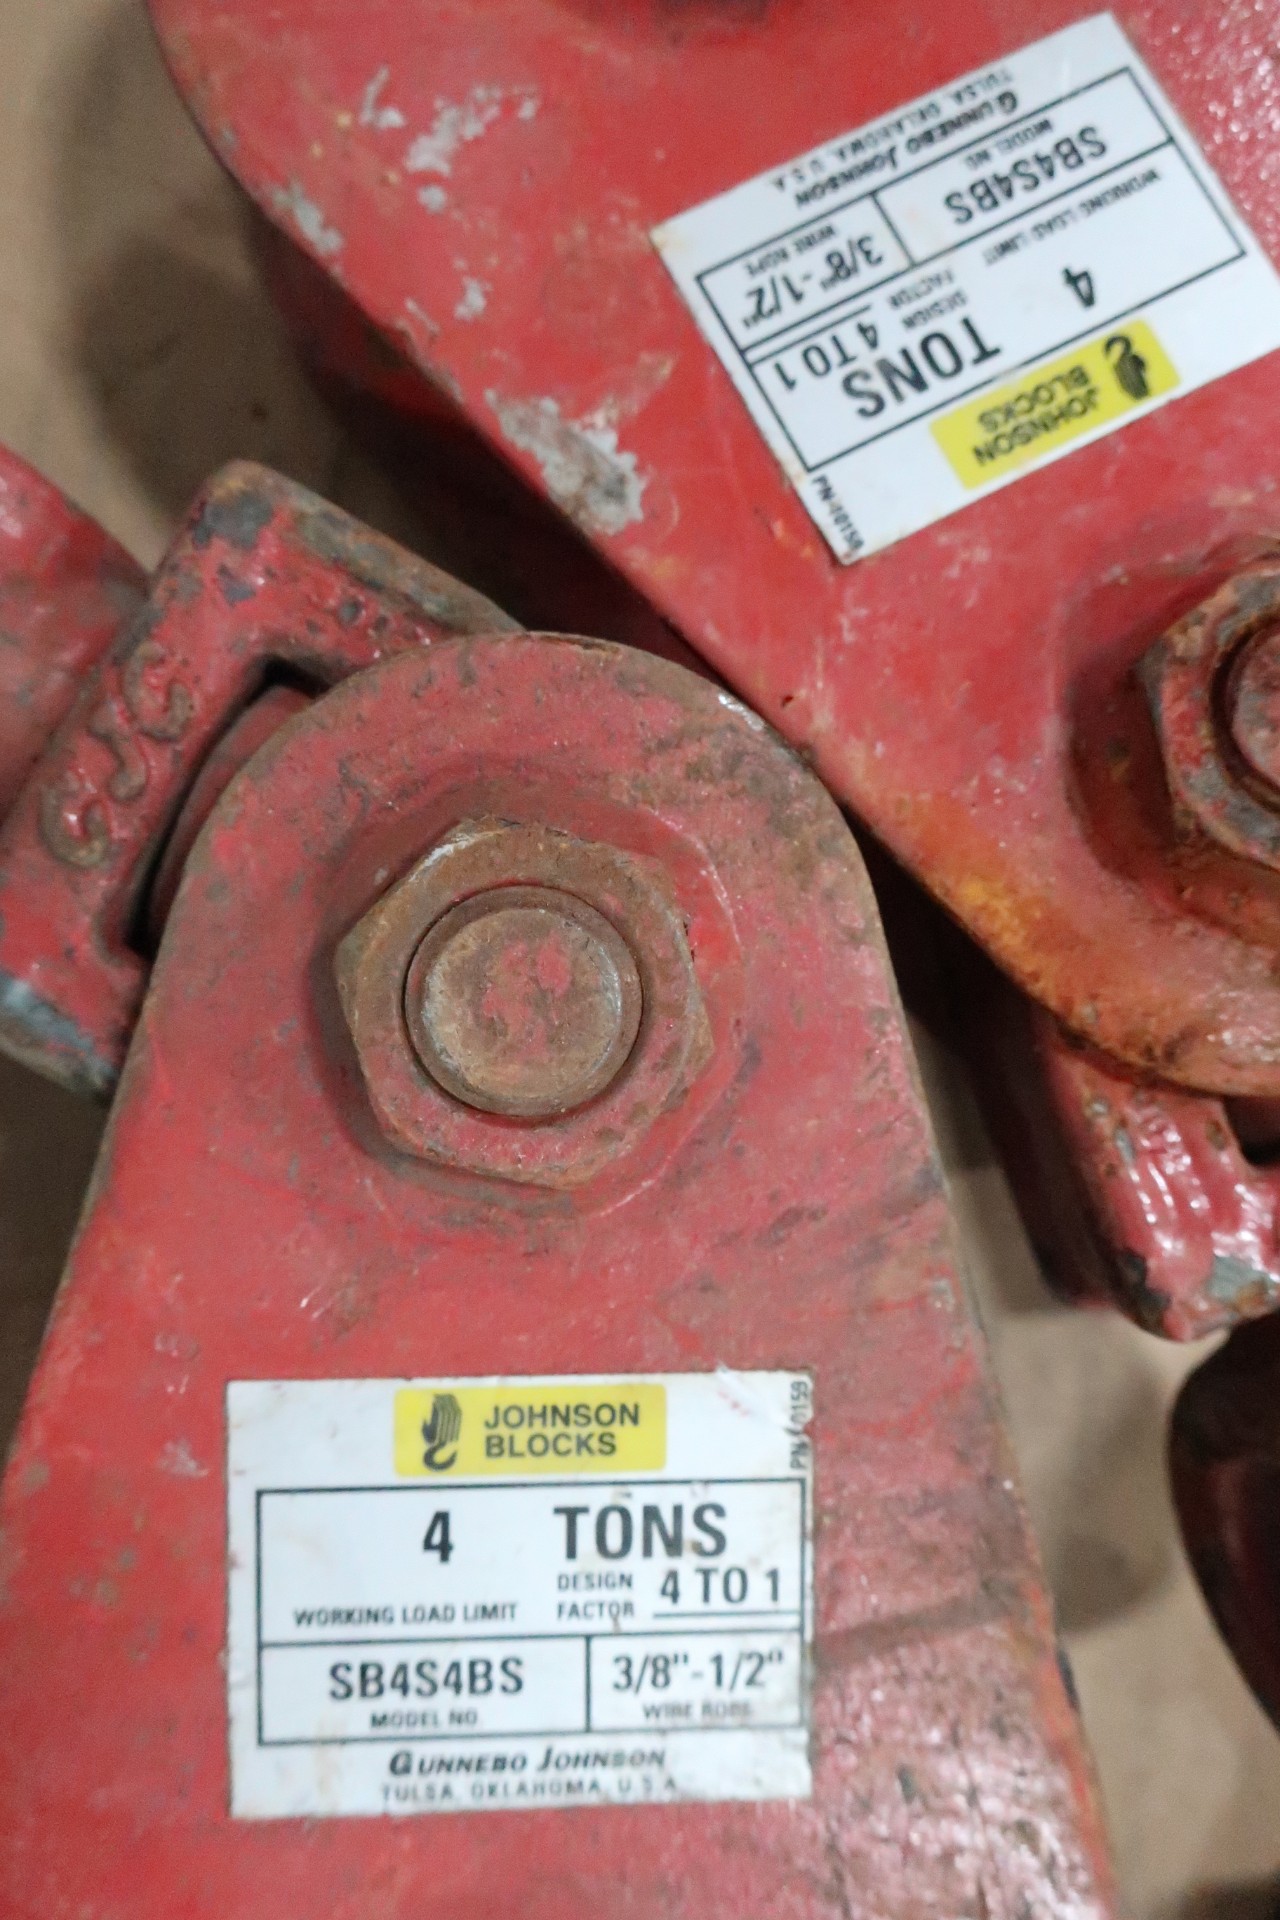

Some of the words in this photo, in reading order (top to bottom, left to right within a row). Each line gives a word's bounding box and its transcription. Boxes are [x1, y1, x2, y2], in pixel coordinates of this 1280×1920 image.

[791, 142, 905, 216] JOHNSON
[941, 120, 1109, 229] SB4S4BS
[885, 265, 956, 313] FACTOR
[1058, 258, 1104, 312] 4
[899, 287, 968, 333] DESIGN
[852, 315, 883, 352] 4
[771, 357, 799, 392] 1
[797, 330, 853, 380] TO
[837, 308, 1000, 424] TONS
[974, 361, 1091, 438] BLOCKS
[970, 382, 1106, 467] JOHNSON
[484, 1403, 640, 1430] JOHNSON
[484, 1432, 616, 1459] BLOCKS
[422, 1510, 453, 1564] 4
[554, 1502, 727, 1561] TONS
[557, 1572, 633, 1592] DESIGN
[660, 1569, 680, 1605] 4
[694, 1568, 748, 1604] TO
[765, 1568, 781, 1602] 1
[294, 1607, 395, 1628] WORKING
[402, 1605, 456, 1623] LOAD
[463, 1602, 518, 1622] LIMIT
[557, 1601, 635, 1621] FACTOR
[330, 1657, 523, 1700] SB4S4BS
[370, 1710, 442, 1729] MODEL
[642, 1701, 693, 1720] WIRE
[388, 1749, 526, 1778] GUNNEBO
[537, 1745, 666, 1772] JOHNSON
